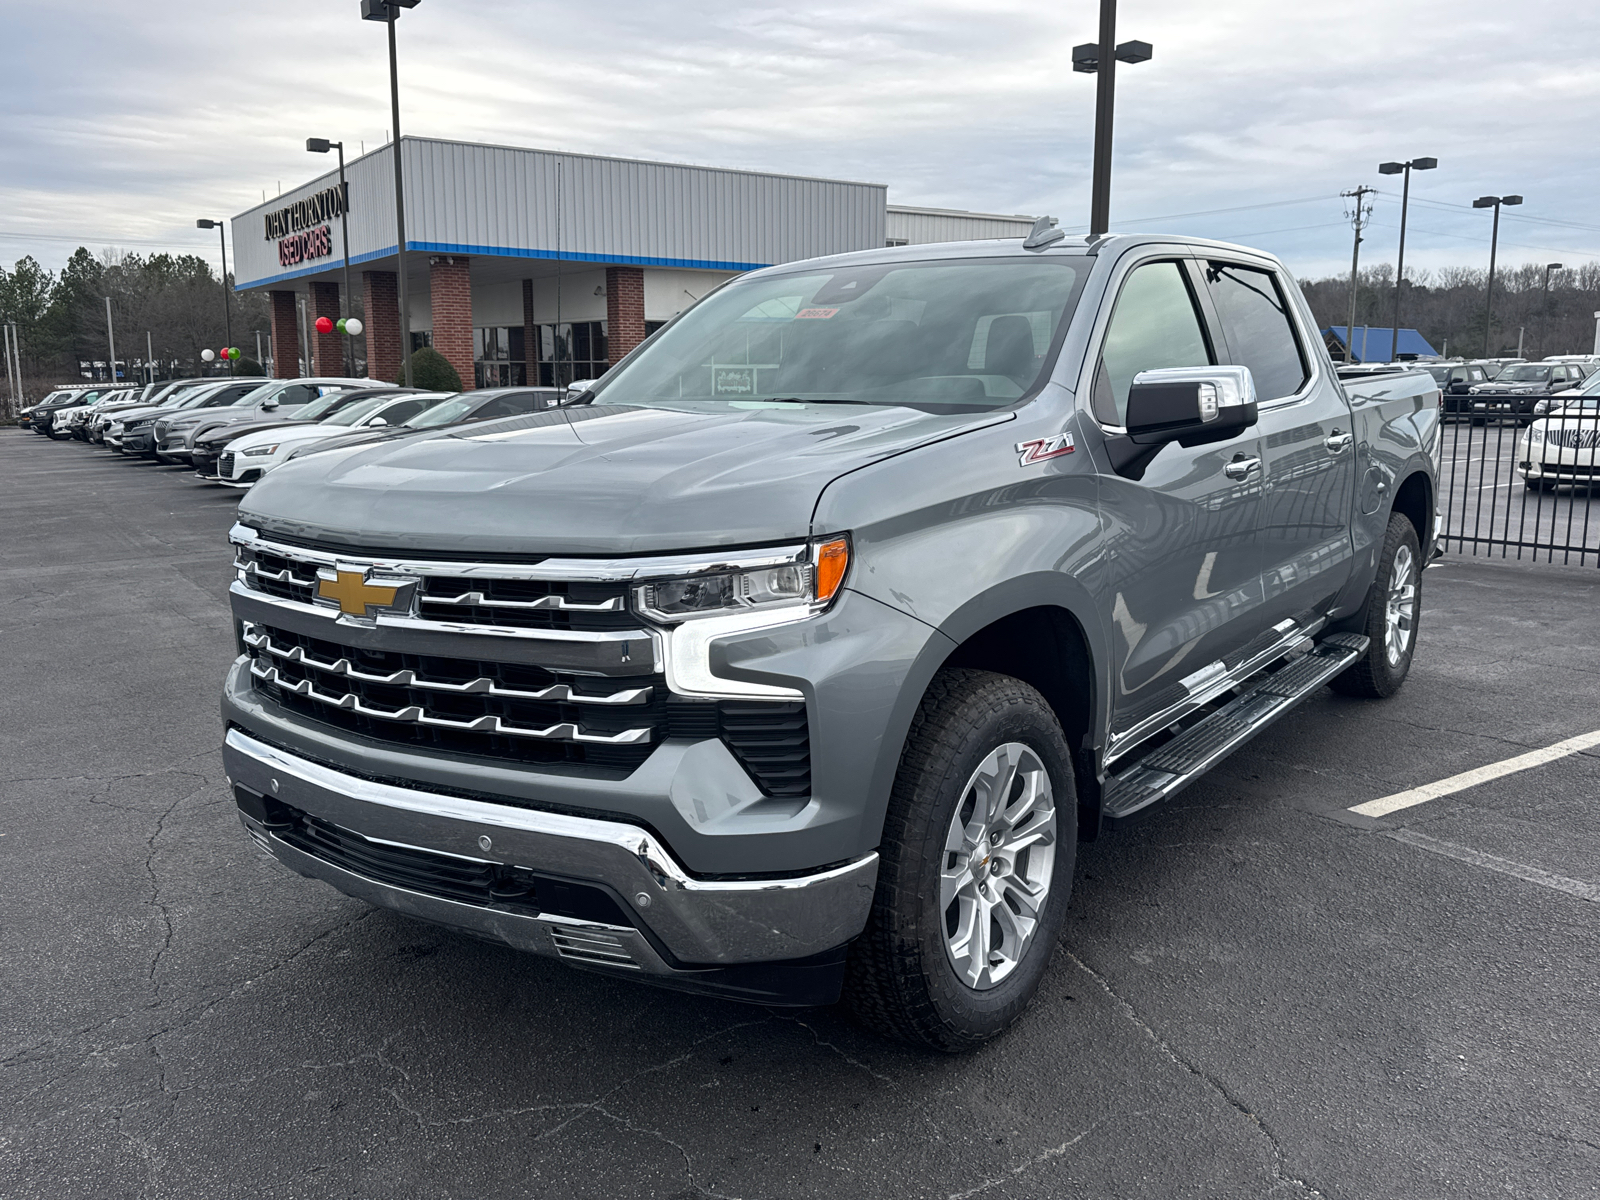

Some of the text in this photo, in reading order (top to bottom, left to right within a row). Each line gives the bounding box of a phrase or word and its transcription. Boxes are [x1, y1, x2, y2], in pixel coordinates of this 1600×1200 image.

[264, 208, 289, 241] JOHN
[278, 225, 332, 266] USED CARS
[1015, 431, 1075, 467] Z71
